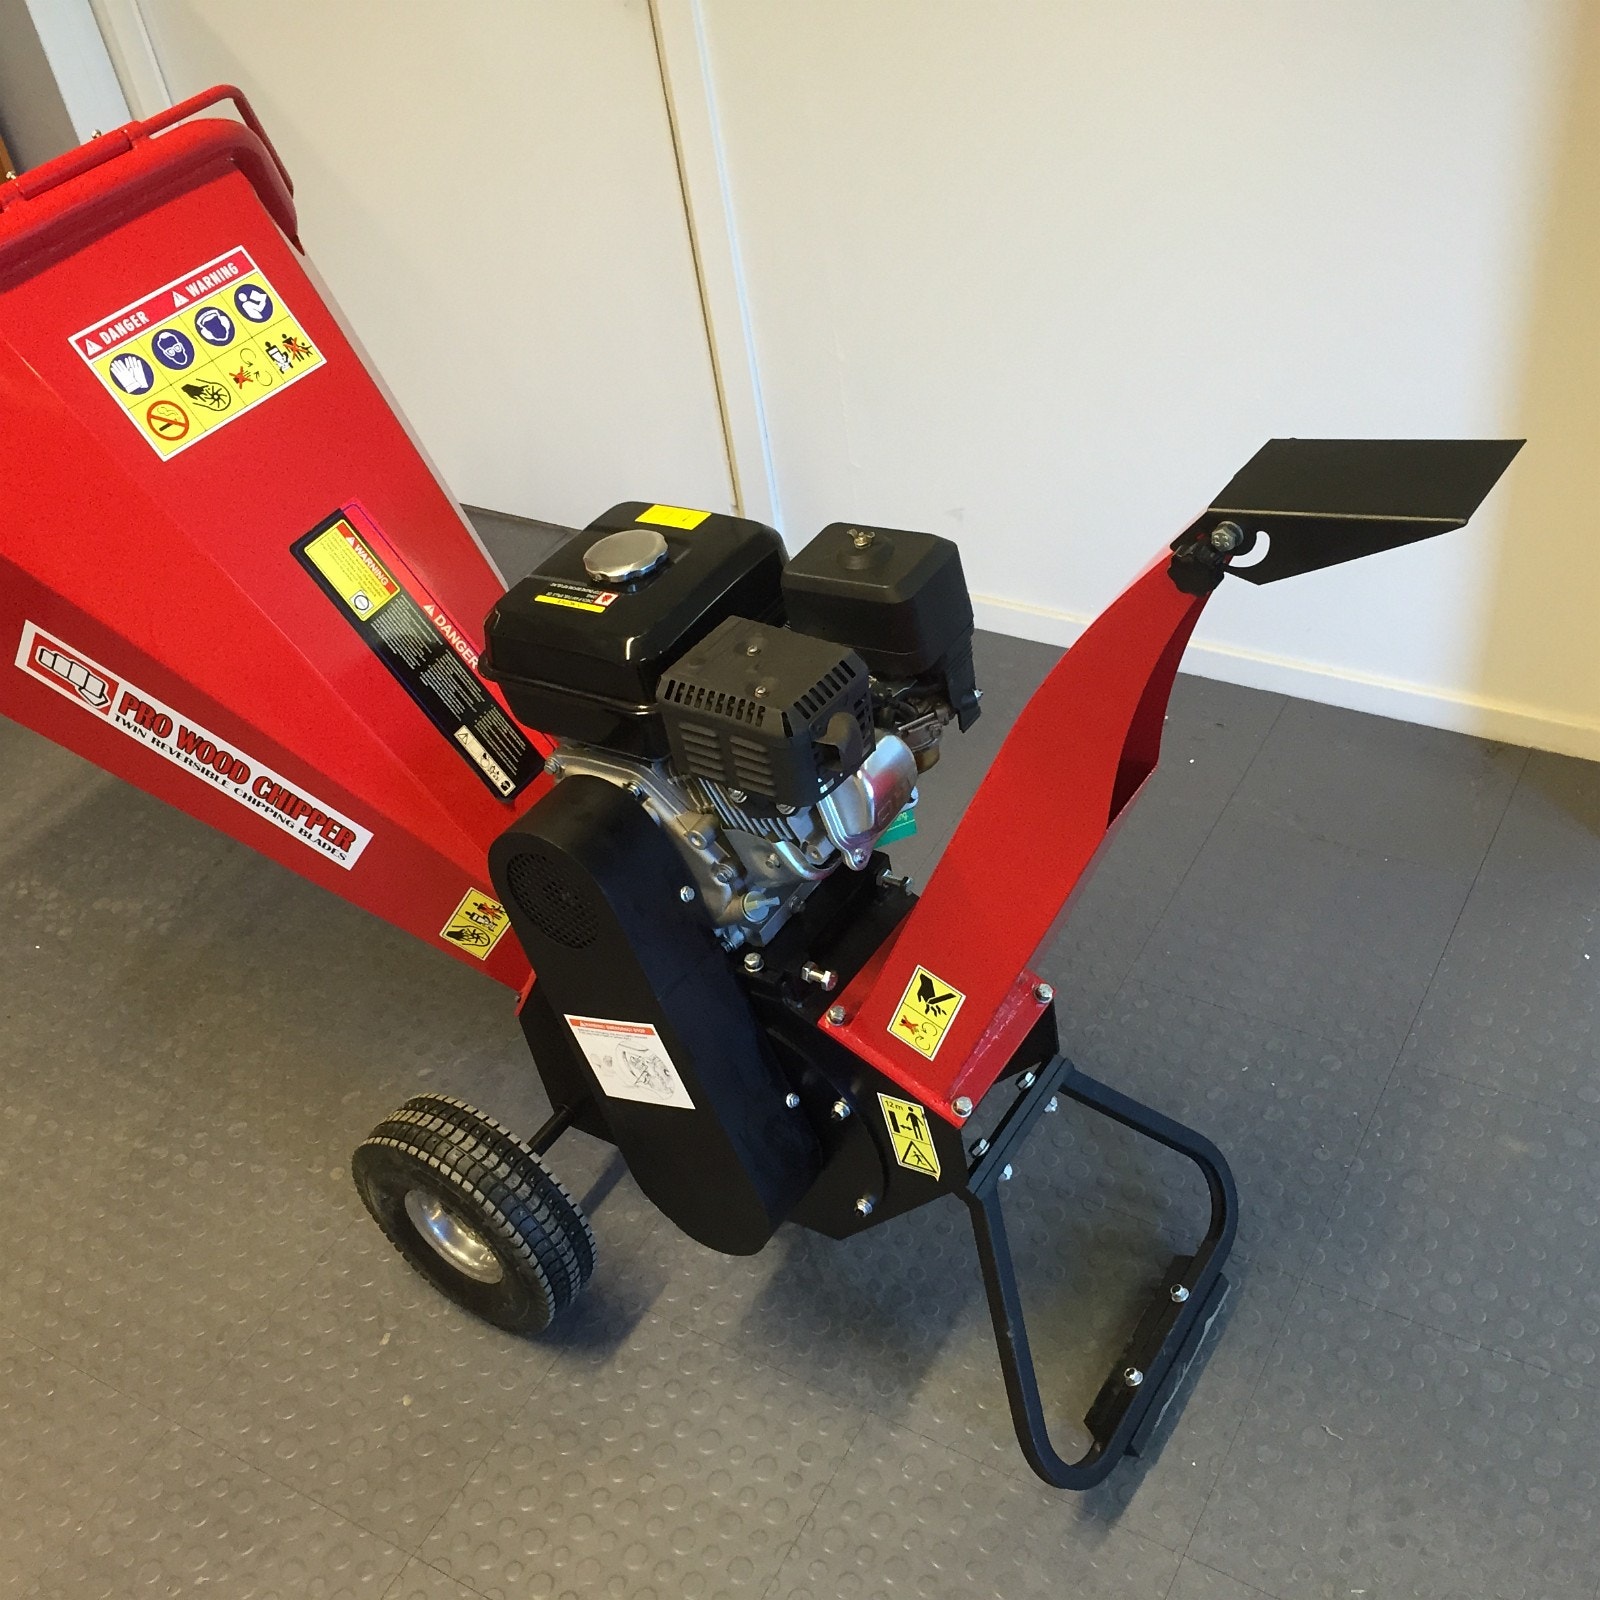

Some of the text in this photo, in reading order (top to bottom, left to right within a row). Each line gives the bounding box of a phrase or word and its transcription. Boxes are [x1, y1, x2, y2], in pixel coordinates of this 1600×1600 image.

[99, 262, 239, 345] DANGER WARNING
[354, 544, 389, 586] WARNING
[433, 614, 479, 669] DANGER
[115, 713, 347, 861] TWIN REVERSIBLE CHIPPING BLADES
[118, 691, 357, 853] PRO WOOD CHIPPER
